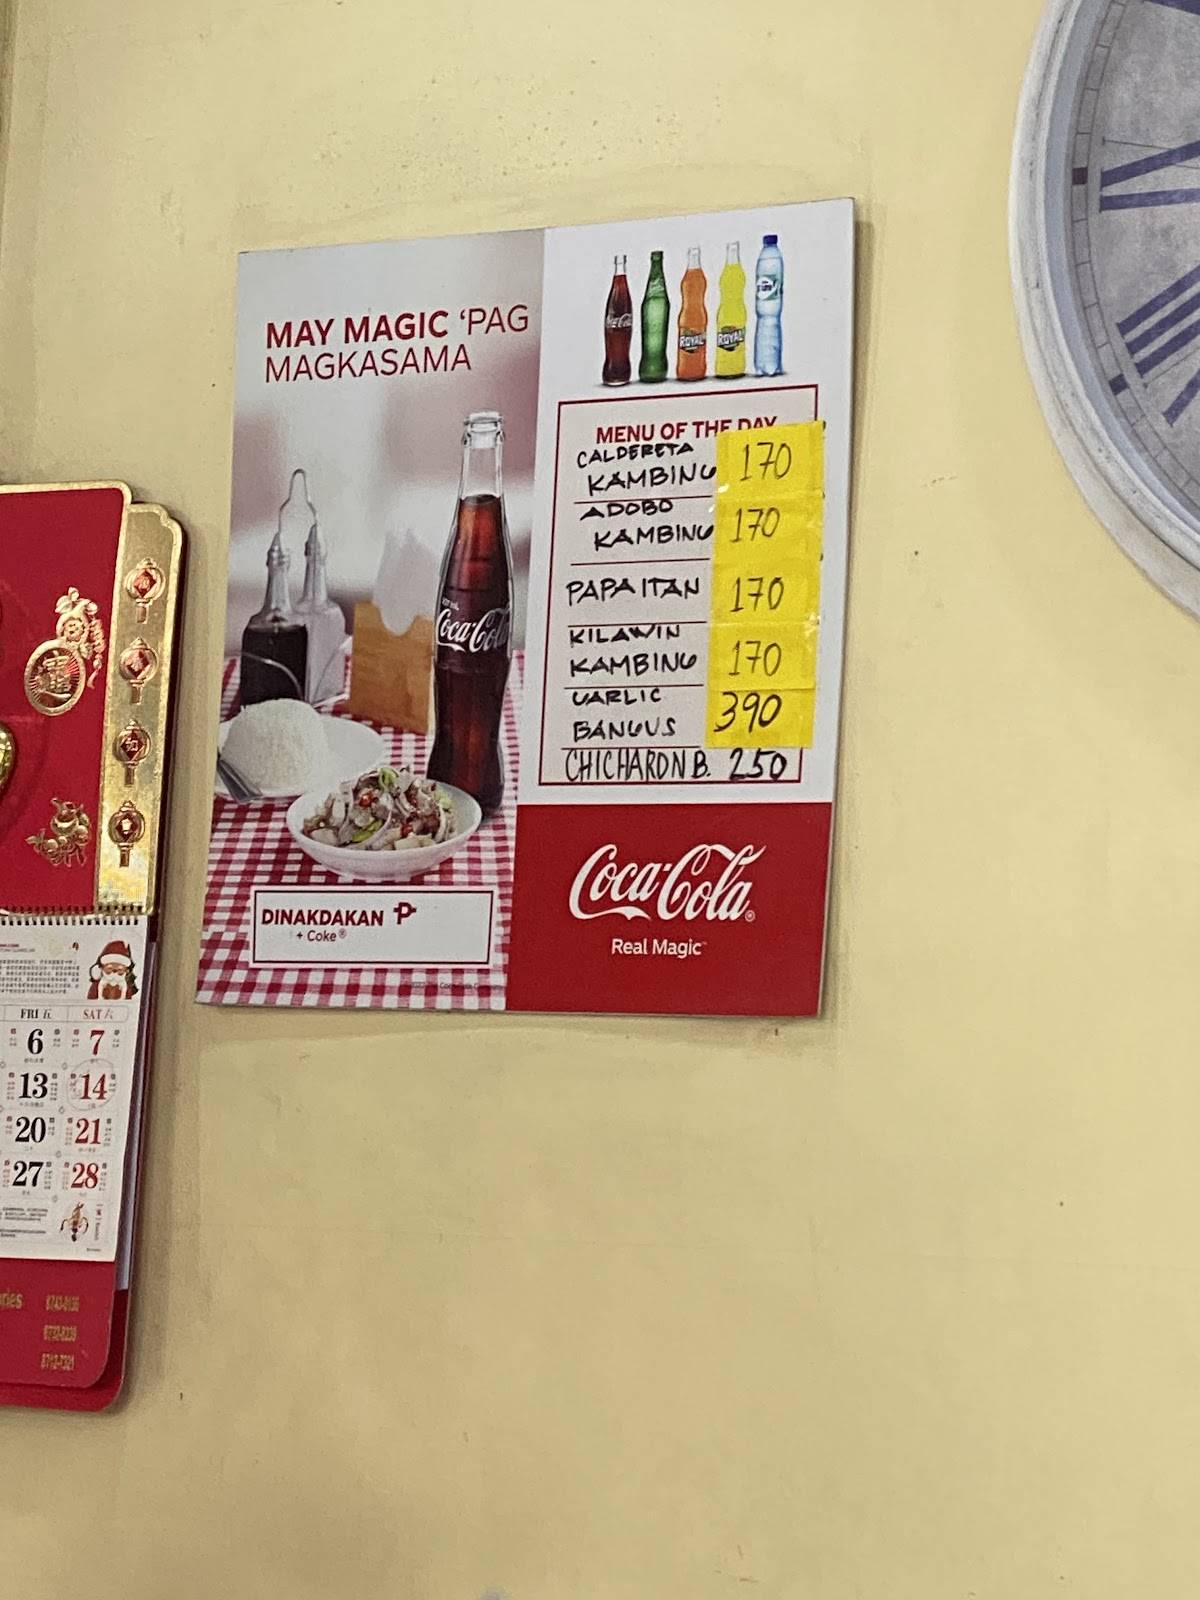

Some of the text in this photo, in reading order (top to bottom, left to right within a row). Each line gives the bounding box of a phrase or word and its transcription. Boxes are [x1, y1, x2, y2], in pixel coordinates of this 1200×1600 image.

[266, 318, 335, 349] MAY
[344, 310, 449, 344] MAGIC
[265, 343, 472, 383] MAGKASAMA
[596, 424, 655, 444] MENU
[660, 422, 688, 441] OF
[692, 419, 732, 439] THE
[577, 442, 694, 469] CALDERETA
[740, 442, 792, 482] 170
[579, 500, 673, 521] ADOBO
[730, 507, 781, 543] 170
[730, 577, 784, 612] 170
[570, 624, 680, 648] KILAWIN
[728, 640, 782, 676] 170
[713, 691, 782, 733] 390
[729, 747, 787, 781] 250
[261, 908, 384, 927] DINAKDAKAN
[611, 938, 703, 959] Real Magic
[20, 1008, 39, 1019] FRI
[83, 1008, 102, 1020] SAT
[27, 1028, 44, 1055] 6
[89, 1029, 105, 1055] 7
[18, 1072, 48, 1099] 13
[79, 1073, 108, 1100] 14
[15, 1116, 46, 1143] 20
[75, 1118, 101, 1144] 21
[12, 1160, 44, 1187] 27
[71, 1162, 99, 1189] 28
